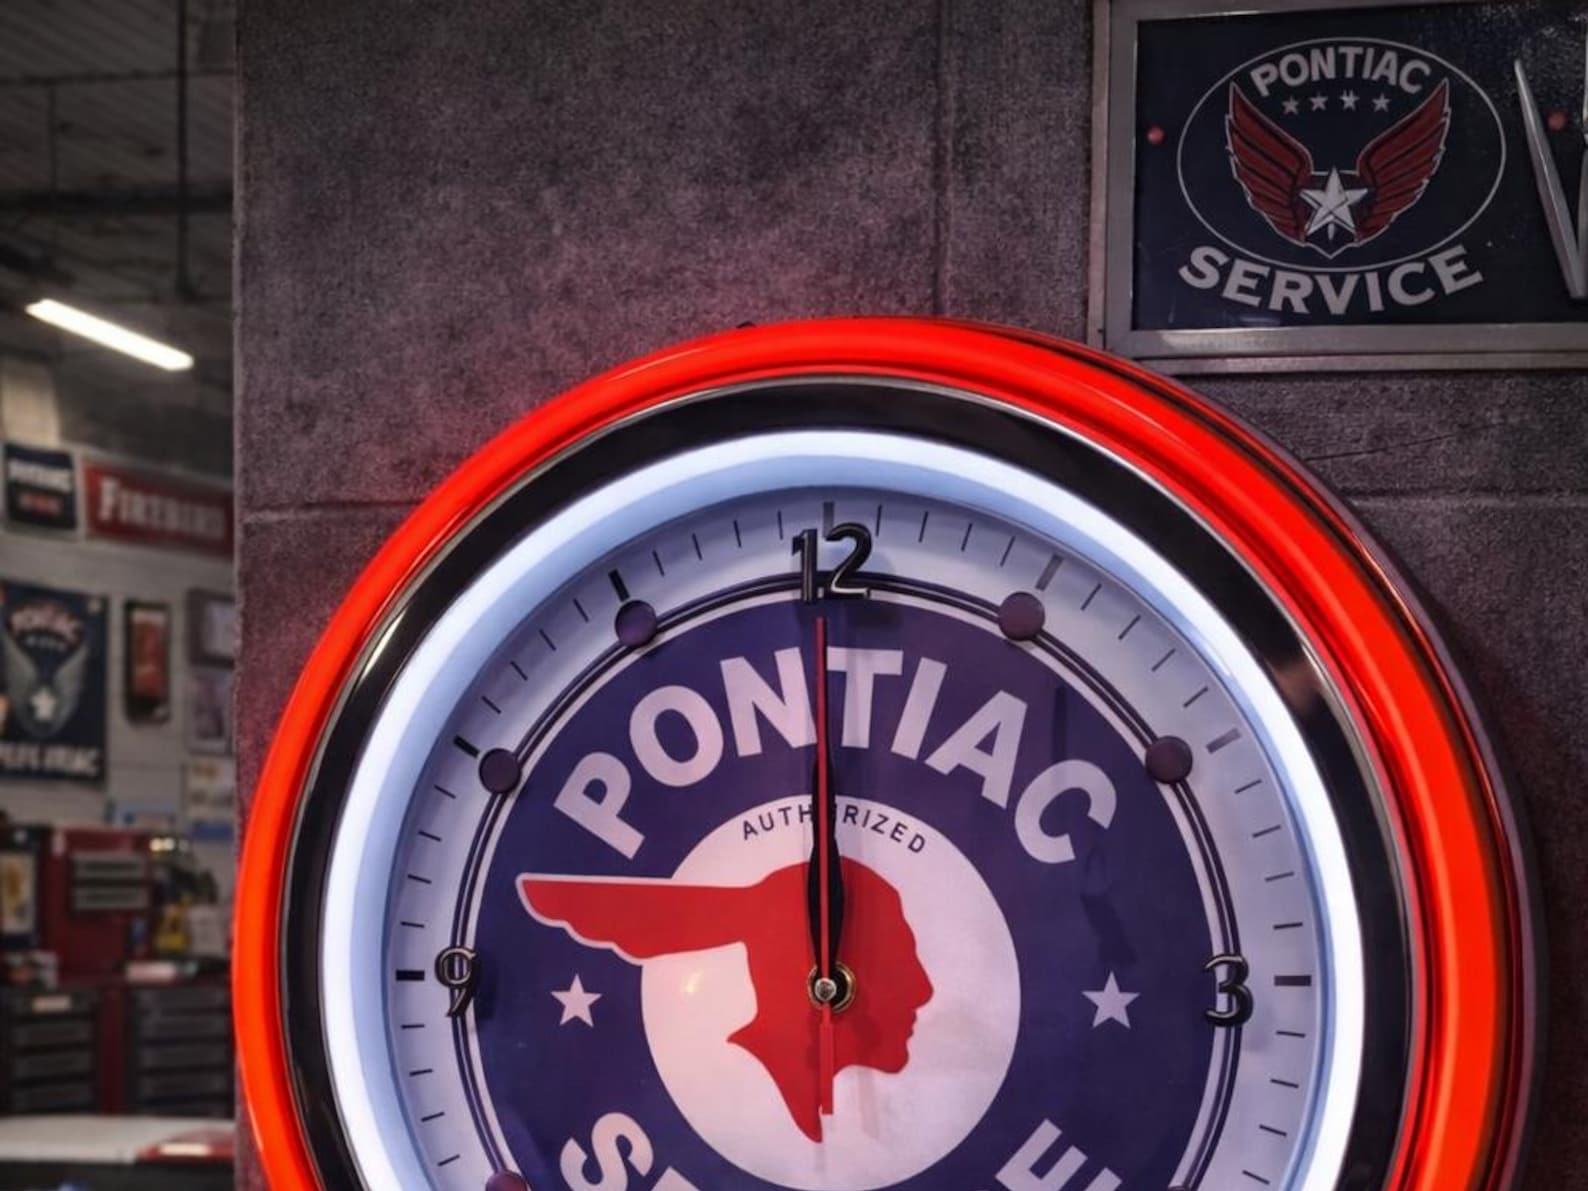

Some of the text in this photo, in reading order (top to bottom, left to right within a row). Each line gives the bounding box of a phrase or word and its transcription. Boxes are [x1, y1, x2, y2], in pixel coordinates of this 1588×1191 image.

[1249, 46, 1432, 97] PONTIAC
[1178, 245, 1484, 315] SERVICE
[792, 522, 872, 604] 12
[553, 646, 1117, 864] PONTIAC
[742, 804, 926, 853] AUTHRIZED
[434, 946, 477, 1018] 9
[1202, 954, 1253, 1027] 3
